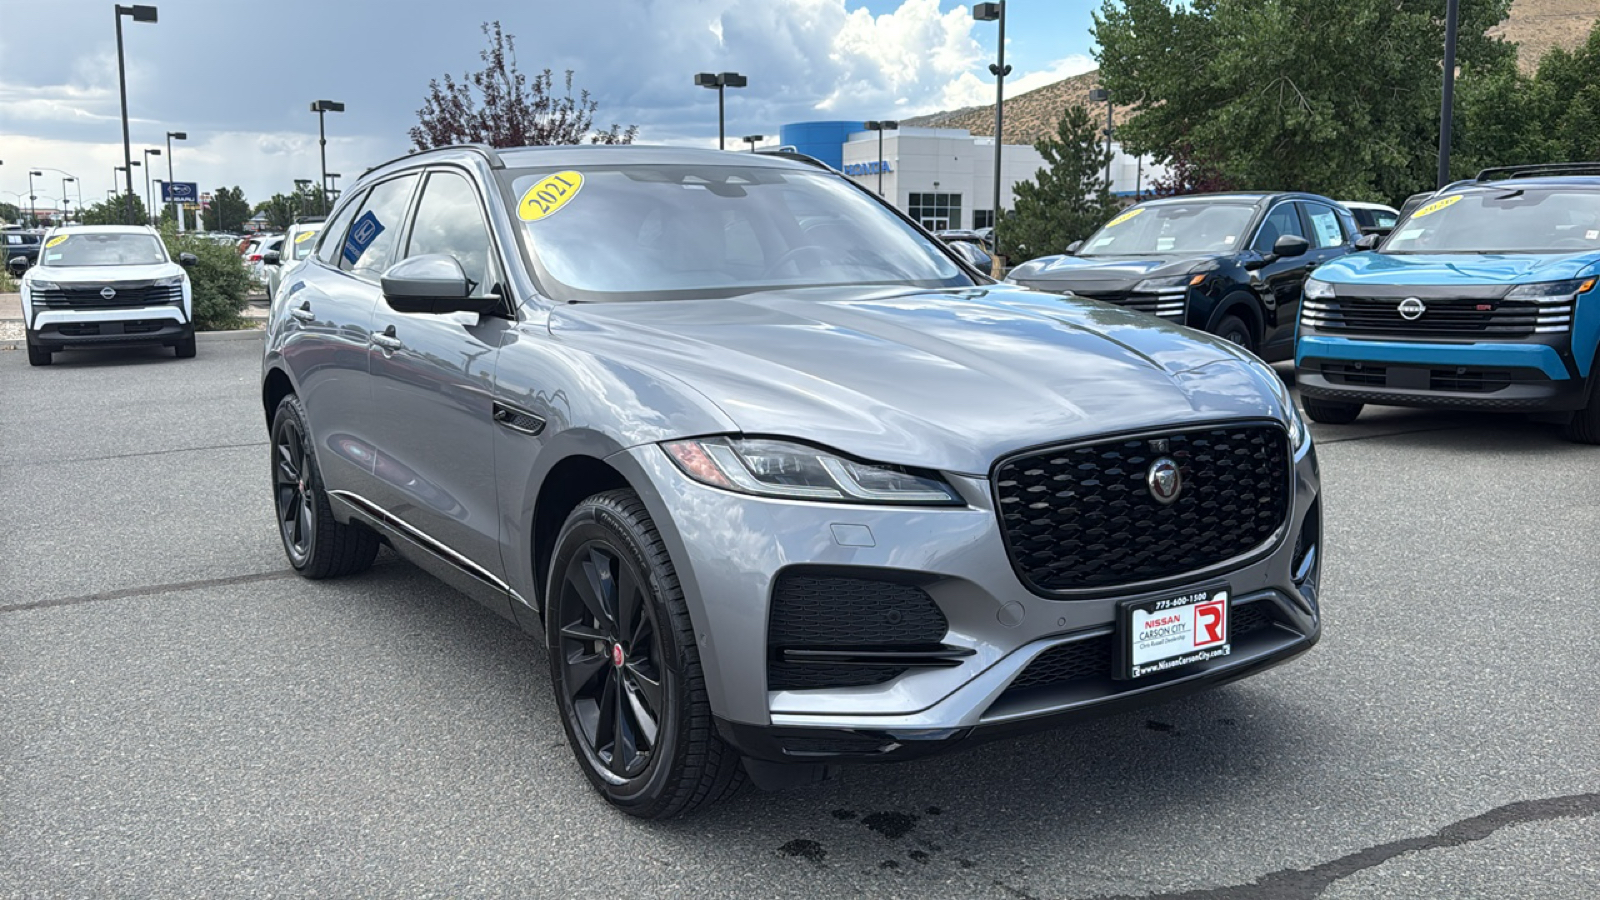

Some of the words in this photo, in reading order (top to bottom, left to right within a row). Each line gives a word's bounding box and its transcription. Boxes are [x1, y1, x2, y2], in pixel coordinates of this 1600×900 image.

[843, 160, 891, 176] HONDA
[528, 175, 575, 214] 2021
[1139, 626, 1171, 641] CARSON
[1171, 622, 1187, 634] CITY
[1144, 614, 1181, 630] NISSAN
[1198, 605, 1221, 643] R
[1140, 649, 1222, 676] www.NissanCarsonCity.com
